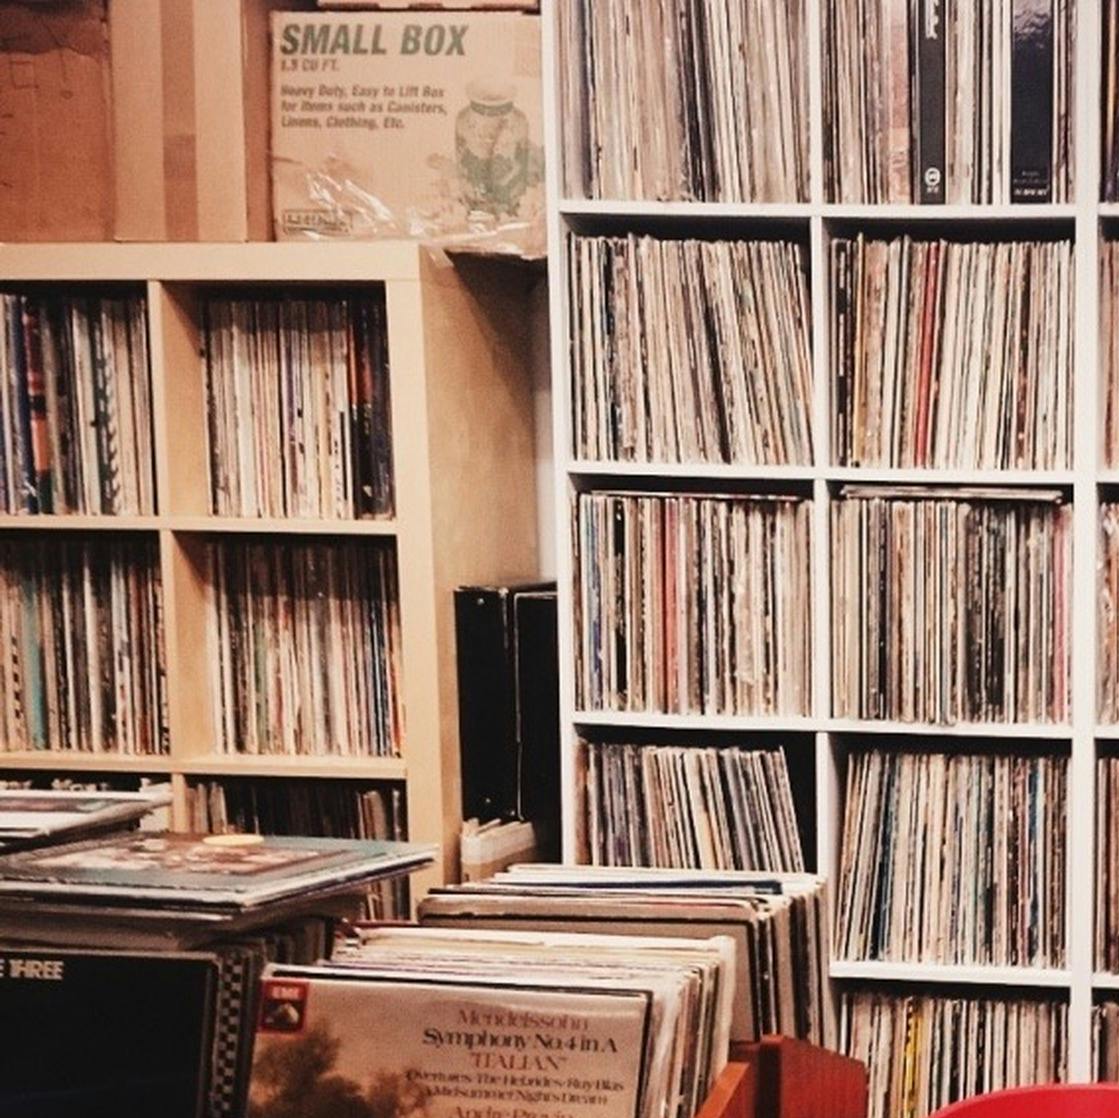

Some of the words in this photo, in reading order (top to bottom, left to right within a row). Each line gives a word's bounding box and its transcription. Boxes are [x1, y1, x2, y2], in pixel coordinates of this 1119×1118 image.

[280, 23, 388, 56] SMALL
[400, 23, 470, 56] BOX
[280, 84, 315, 98] Heavy
[351, 84, 380, 98] Easy
[382, 86, 395, 97] to
[399, 85, 419, 97] Lift
[422, 85, 445, 98] Box
[281, 101, 298, 113] for
[337, 101, 366, 113] such
[369, 102, 384, 113] as
[9, 959, 64, 979] THREE
[456, 1008, 590, 1032] Mendelssohn
[421, 1028, 526, 1051] Symphony
